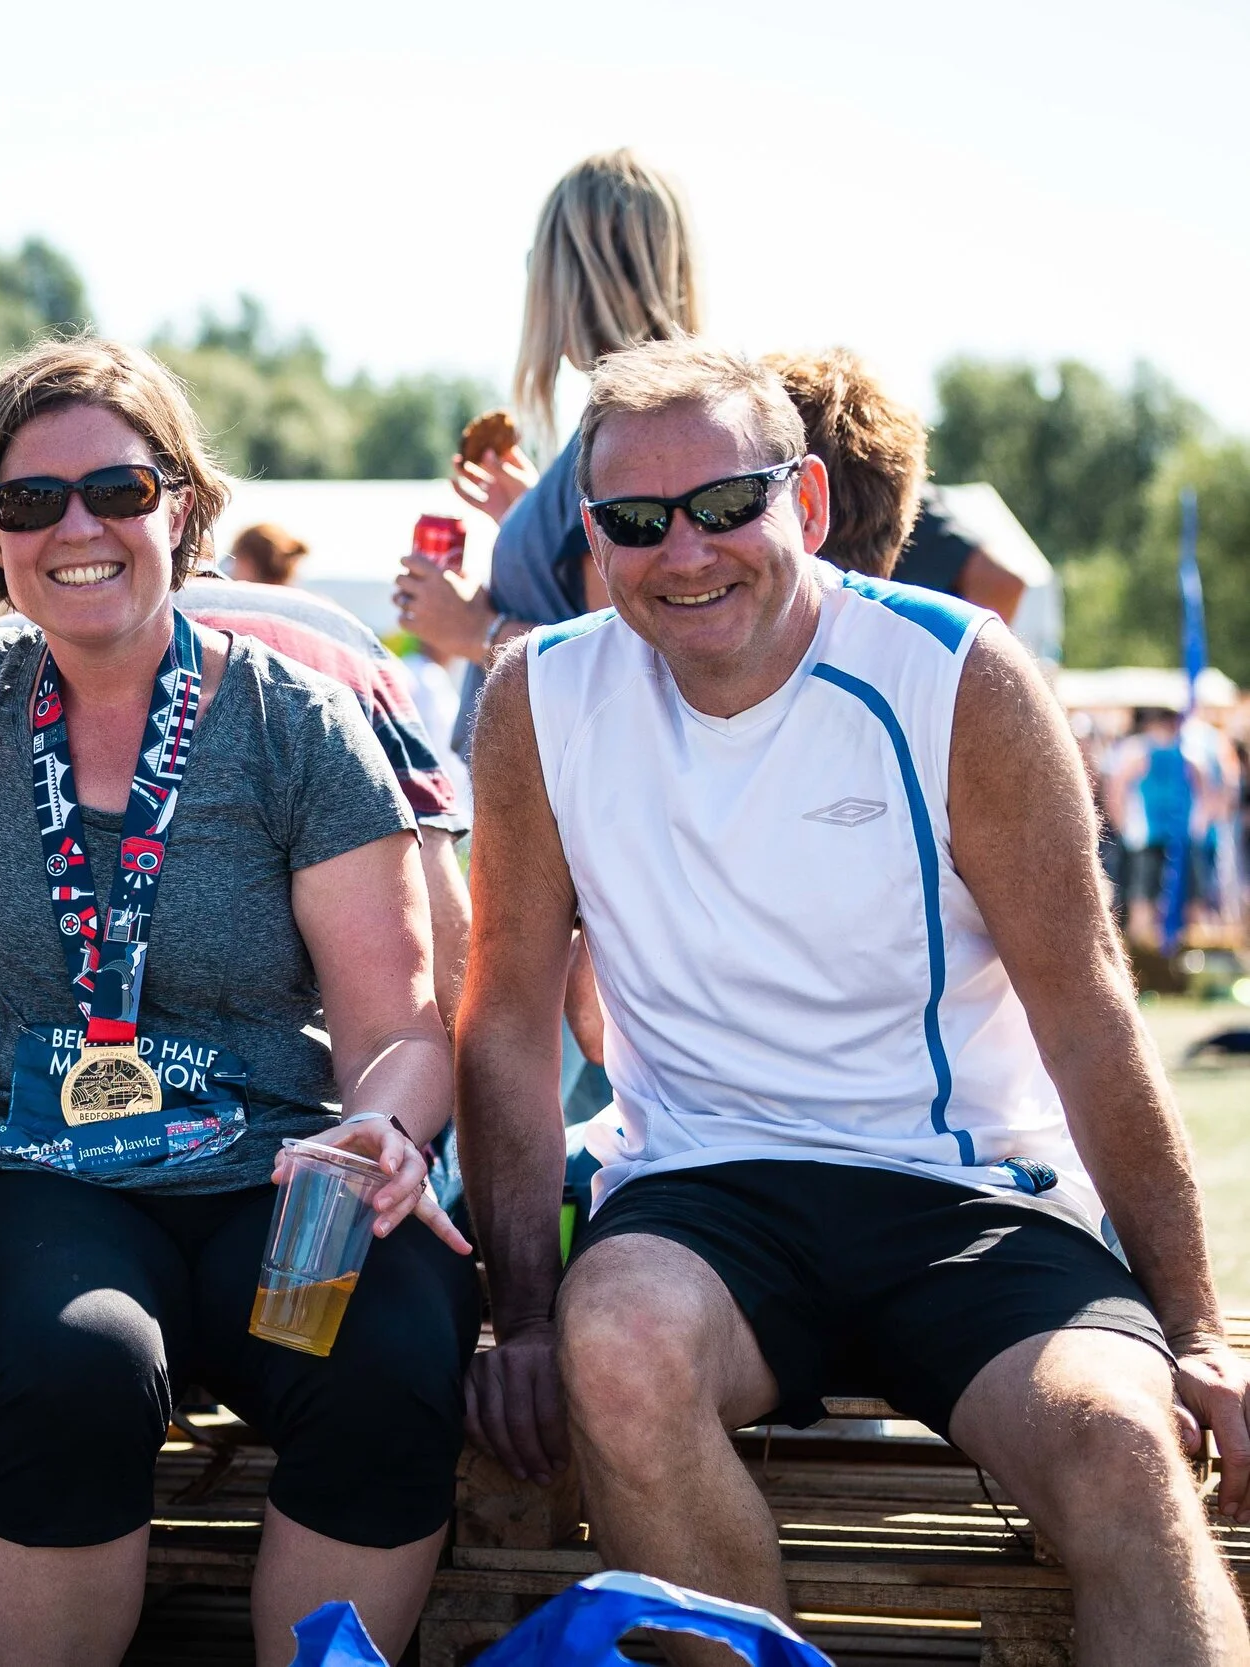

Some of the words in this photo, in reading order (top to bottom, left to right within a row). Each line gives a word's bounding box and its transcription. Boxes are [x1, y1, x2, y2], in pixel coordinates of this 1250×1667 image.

[99, 1052, 138, 1064] MARATHON
[161, 1039, 219, 1068] HALF
[79, 1111, 122, 1121] BEDFORD
[78, 1144, 115, 1162] james
[123, 1135, 162, 1151] lawler
[91, 1151, 152, 1166] FINANCIAL
